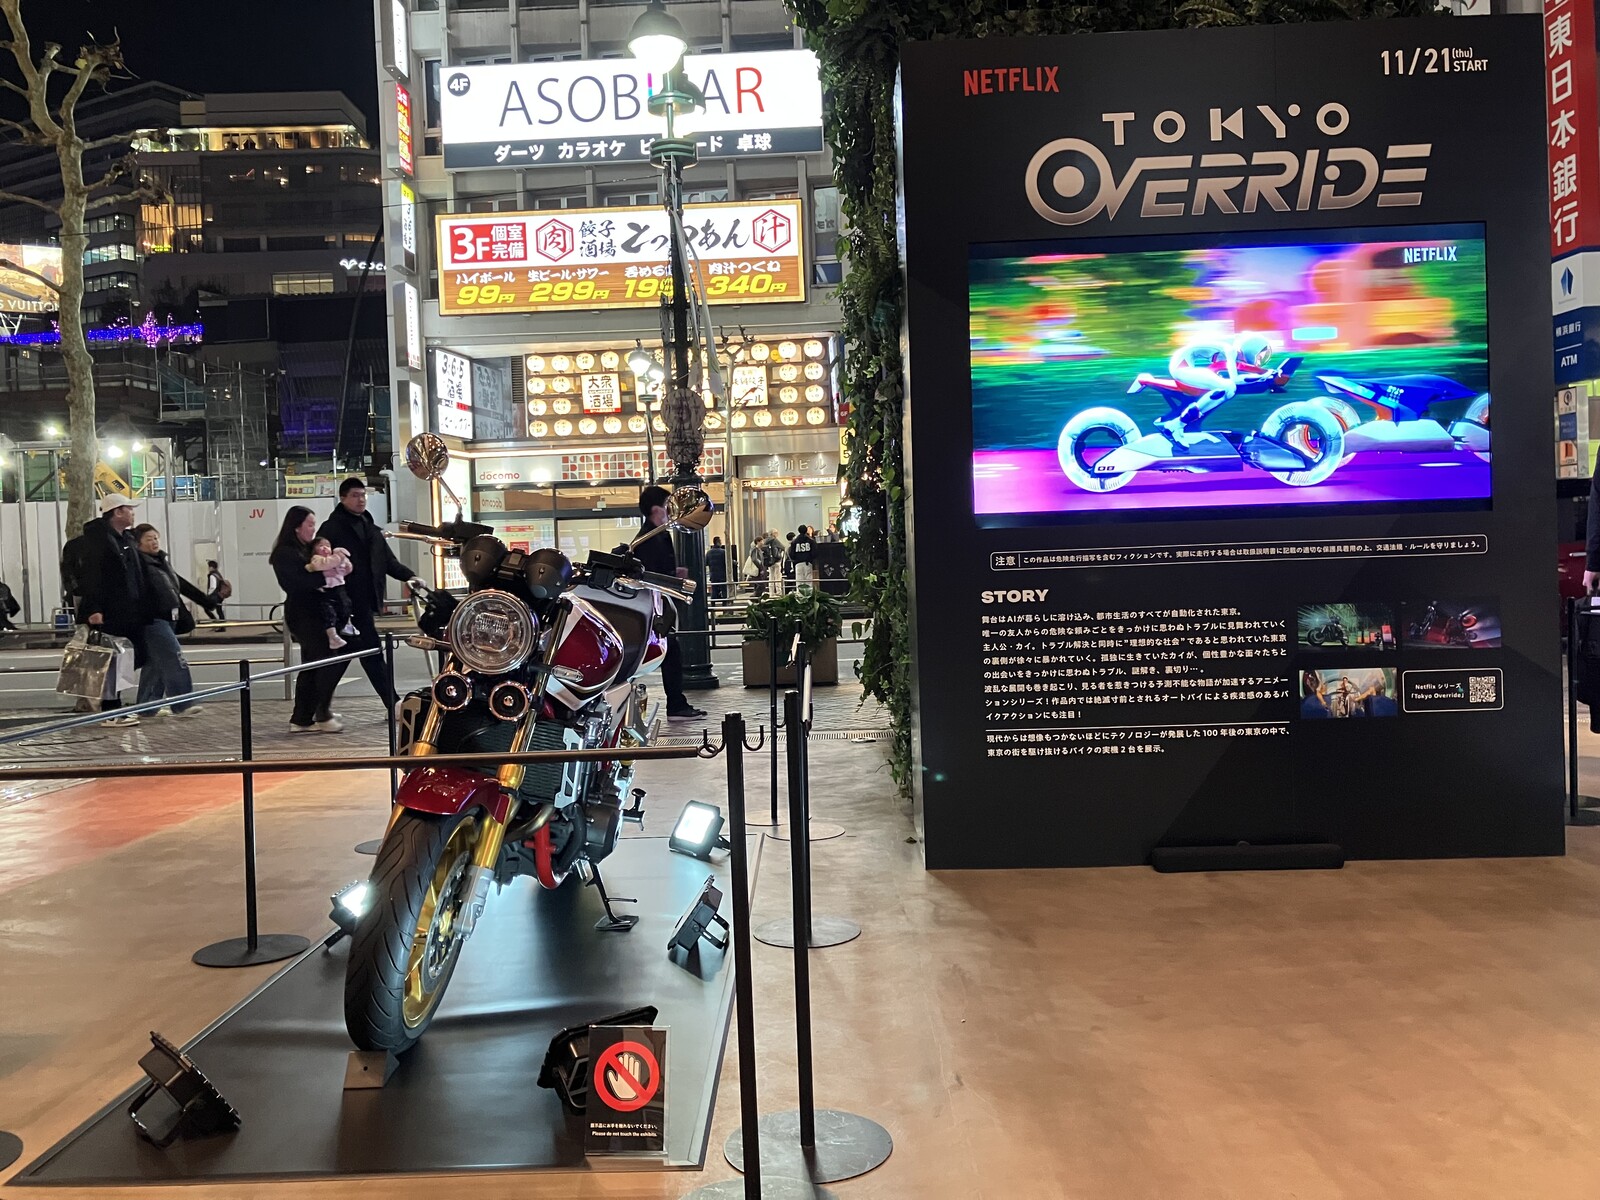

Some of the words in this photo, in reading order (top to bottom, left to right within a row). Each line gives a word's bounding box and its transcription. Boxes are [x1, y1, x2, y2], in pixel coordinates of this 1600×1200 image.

[1381, 47, 1450, 75] 11/21
[1452, 47, 1473, 59] (thu)
[1453, 59, 1488, 72] START
[449, 77, 469, 91] 4F
[963, 66, 1060, 96] NETFLIX
[1102, 102, 1350, 146] TOKYO
[1548, 12, 1578, 248] 東日本銀行
[494, 144, 544, 163] ダーツ
[558, 140, 626, 159] カラオケ
[736, 132, 772, 151] 卓球
[1025, 137, 1432, 226] OVERRIDE
[491, 224, 524, 242] 個室
[579, 219, 616, 239] 餃子
[760, 215, 786, 245] 汁
[453, 227, 491, 262] 3F
[543, 225, 568, 254] 肉
[580, 239, 617, 258] 酒場
[492, 241, 525, 260] 完備
[1404, 246, 1457, 264] NETFLIX
[527, 267, 609, 283] 生ビール・サワー
[708, 260, 781, 276] 肉汁つくね
[455, 271, 516, 285] ハイボール
[706, 274, 788, 296] 340円
[456, 284, 516, 305] 99円
[528, 281, 610, 302] 299円
[1560, 353, 1578, 368] ATM
[479, 472, 520, 481] docomo
[249, 508, 265, 519] JV
[795, 542, 811, 553] ASB
[995, 555, 1016, 566] 注意
[981, 589, 1049, 604] STORY
